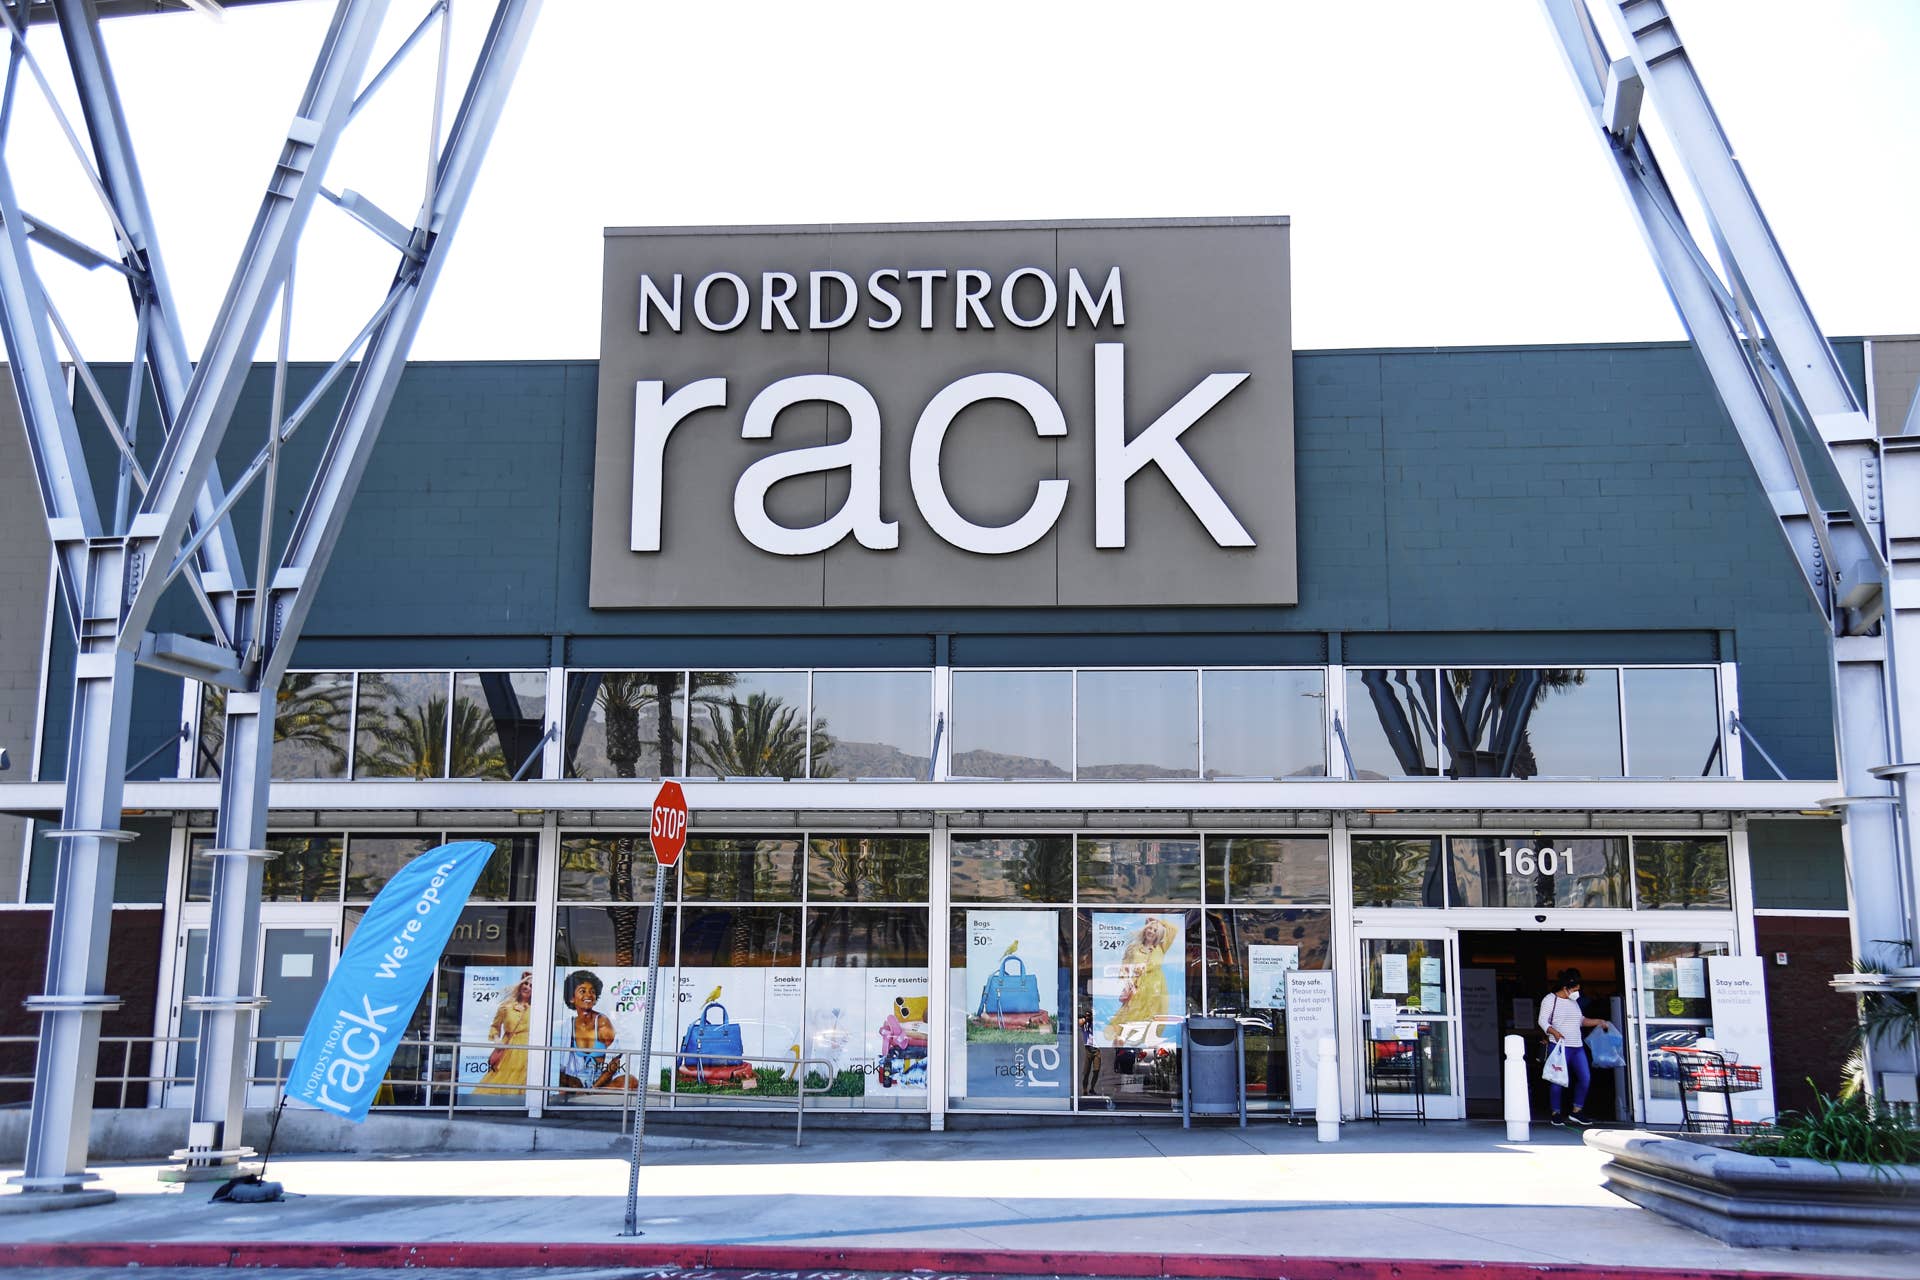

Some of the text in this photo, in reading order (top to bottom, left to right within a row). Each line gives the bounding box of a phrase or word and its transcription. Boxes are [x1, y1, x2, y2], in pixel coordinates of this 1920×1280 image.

[638, 266, 1126, 332] NORDSTROM
[630, 342, 1257, 555] rack
[653, 806, 685, 839] STOP
[1499, 847, 1574, 876] 1601
[375, 859, 457, 979] We're open.
[973, 920, 991, 928] Bags
[473, 974, 500, 982] Dresses
[874, 976, 896, 984] Sunny
[1291, 978, 1322, 987] Stay safe.
[1715, 979, 1732, 987] Stay
[610, 981, 648, 996] deal
[302, 1020, 347, 1099] NORDSTROM
[316, 994, 399, 1113] rack
[465, 1061, 497, 1073] rack
[849, 1061, 880, 1075] rack
[995, 1062, 1026, 1077] rack
[1028, 1041, 1060, 1087] ra
